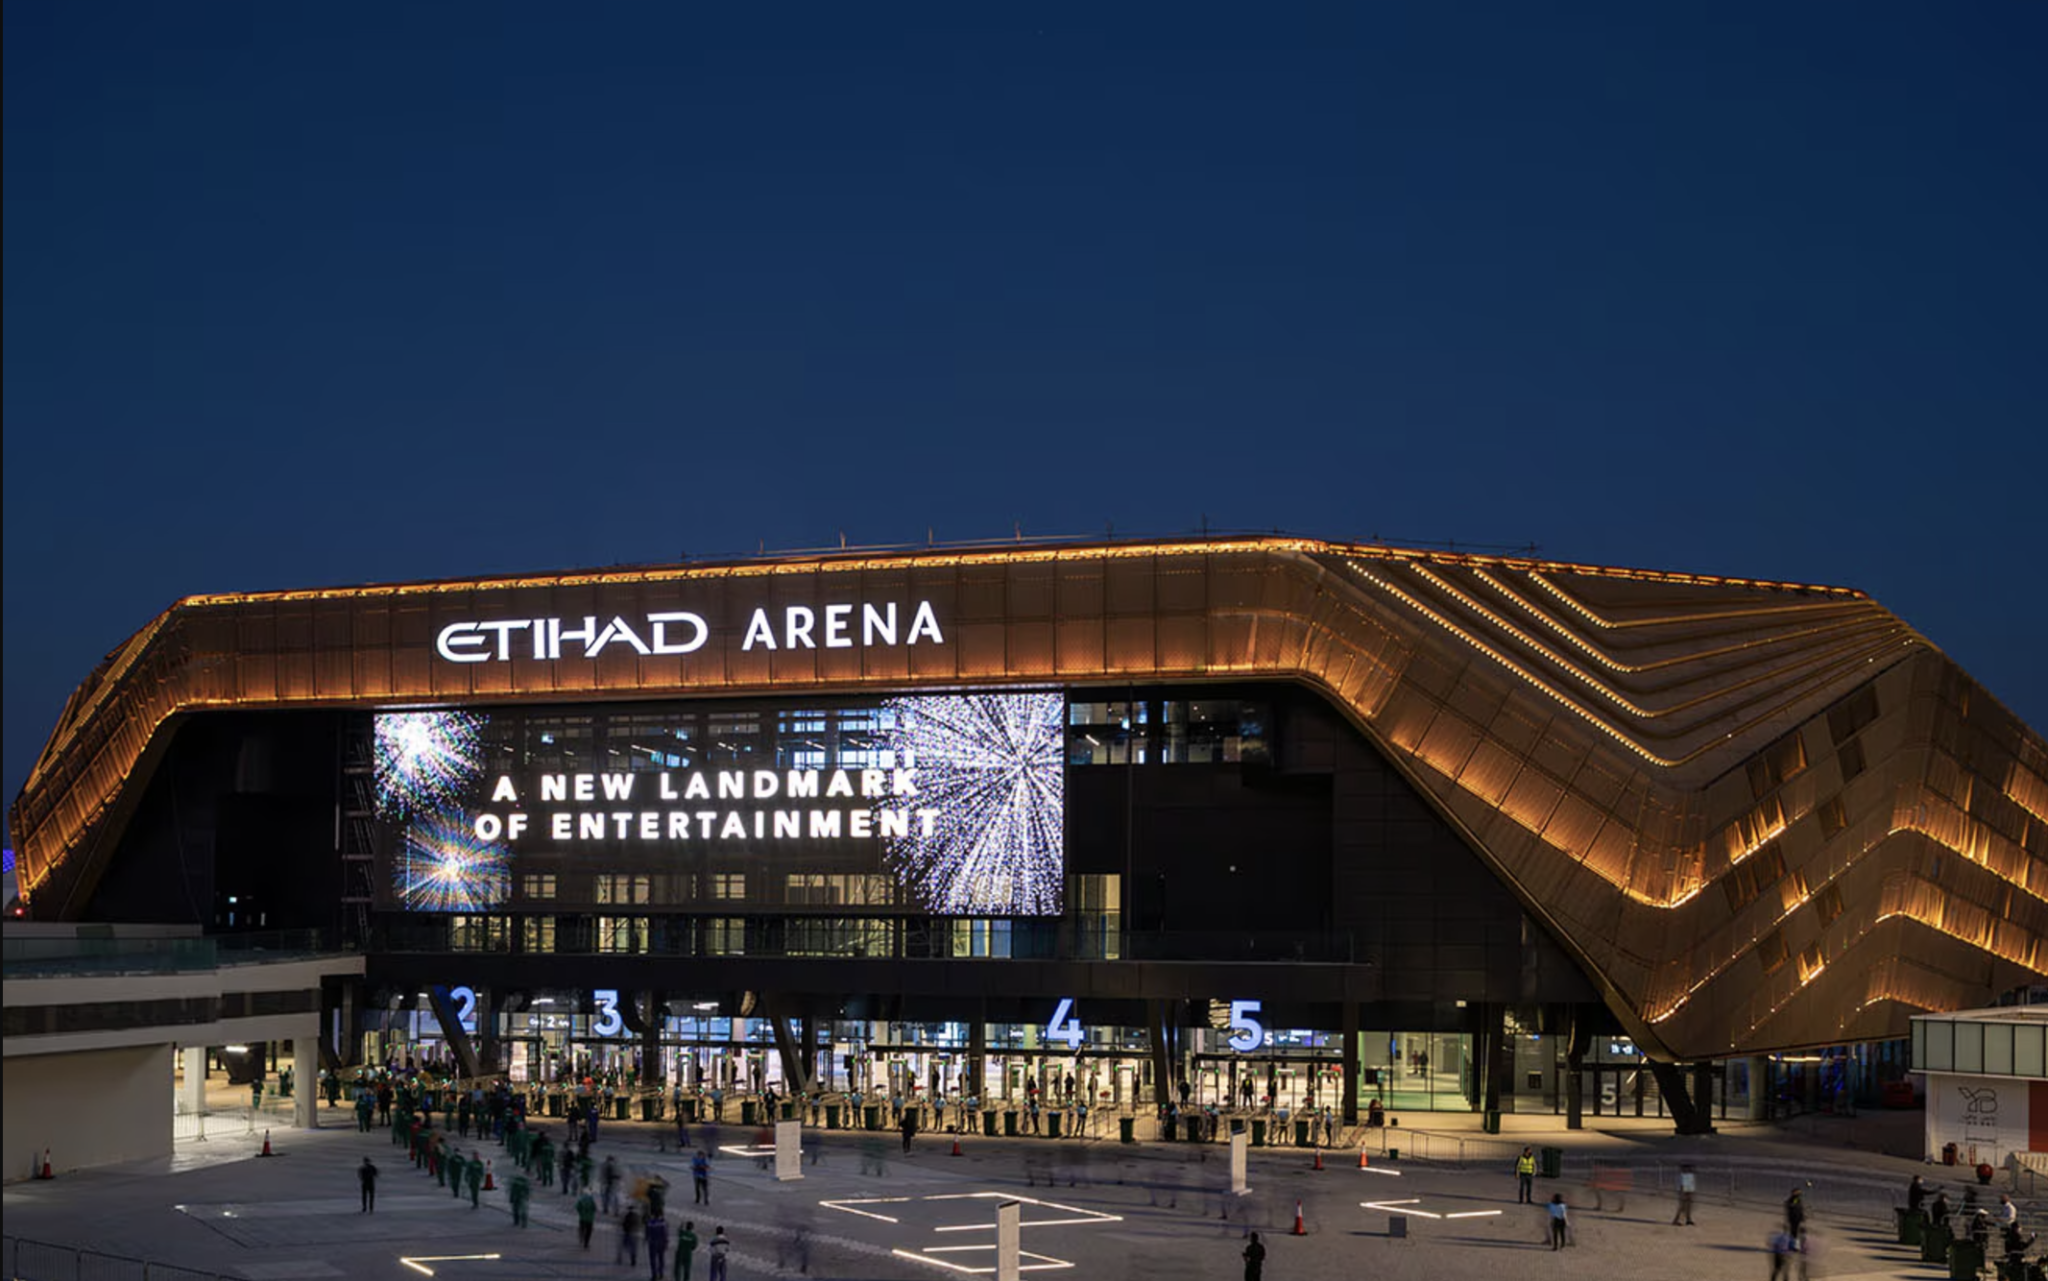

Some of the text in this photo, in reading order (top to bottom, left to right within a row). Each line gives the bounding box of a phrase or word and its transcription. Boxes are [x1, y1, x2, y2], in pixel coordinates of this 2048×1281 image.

[436, 600, 944, 663] ETIHAD ARENA
[491, 768, 920, 802] A NEW LANDMARK
[474, 808, 941, 841] OF ENTERTAINMENT
[450, 986, 477, 1031] 2
[593, 990, 622, 1037] 3
[1046, 998, 1085, 1050] 4
[1228, 1000, 1263, 1052] 5
[1601, 1083, 1617, 1106] 5
